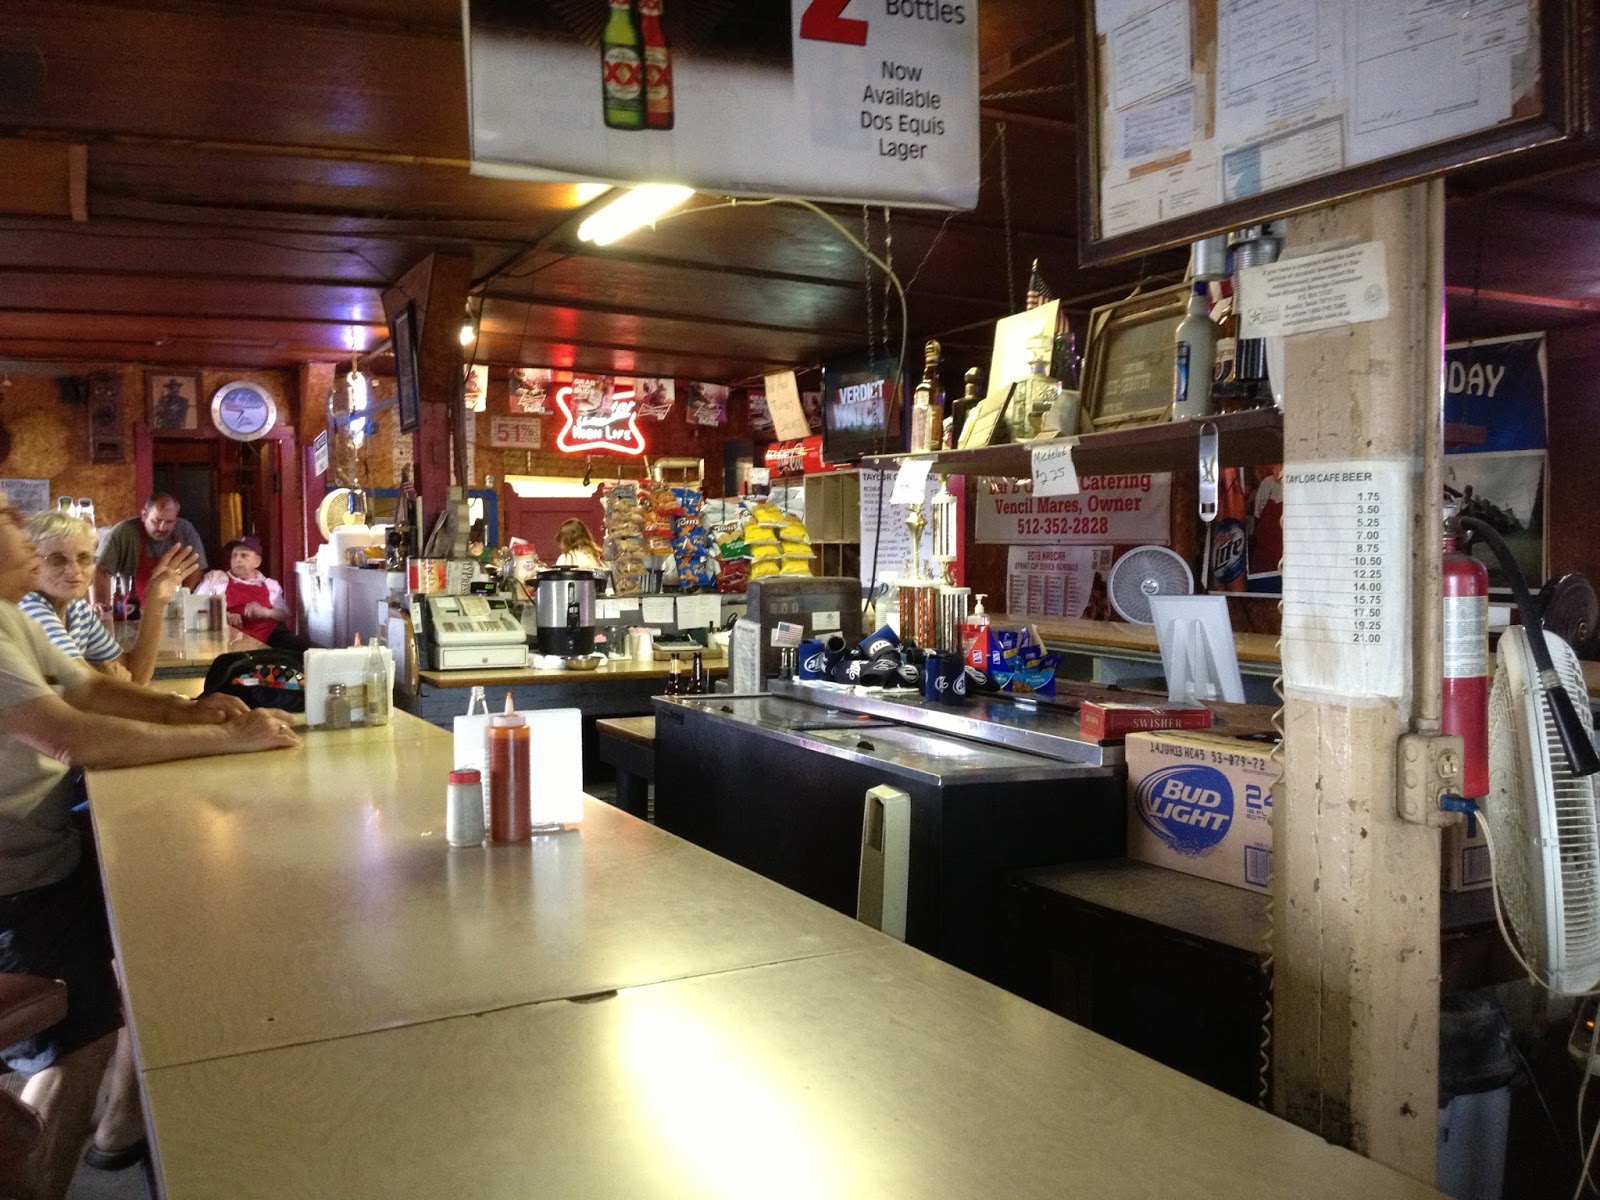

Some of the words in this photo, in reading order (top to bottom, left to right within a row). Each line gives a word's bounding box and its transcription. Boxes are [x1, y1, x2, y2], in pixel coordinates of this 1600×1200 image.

[886, 0, 965, 25] Bottles
[881, 60, 922, 82] Now
[863, 84, 941, 110] Available
[861, 111, 892, 131] Dos
[898, 112, 945, 140] Equis
[879, 137, 928, 161] Lager
[1445, 360, 1505, 398] DAY
[839, 379, 884, 405] VERDICT
[1081, 474, 1152, 492] Catering
[1286, 474, 1316, 484] TAYLOR
[1317, 473, 1340, 483] CAFE
[1342, 472, 1372, 482] BEER
[1357, 492, 1380, 501] 1.75
[995, 498, 1033, 515] Vencil
[1037, 499, 1083, 515] Mares,
[1088, 495, 1142, 512] Owner
[1357, 505, 1380, 514] 3.50
[1018, 517, 1108, 534] 512-352-2828
[1357, 518, 1380, 527] 5.25
[1356, 531, 1380, 540] 7.00
[1356, 544, 1380, 553] 8.75
[1354, 557, 1382, 566] 10.50
[1354, 570, 1382, 579] 12.25
[1353, 583, 1382, 591] 14.00
[1353, 596, 1381, 604] 15.75
[1353, 609, 1381, 617] 17.50
[1354, 621, 1381, 630] 19.25
[1353, 634, 1381, 643] 21.00
[1133, 718, 1182, 729] SWISHER
[1162, 778, 1221, 808] BUD
[1150, 797, 1229, 831] LIGHT
